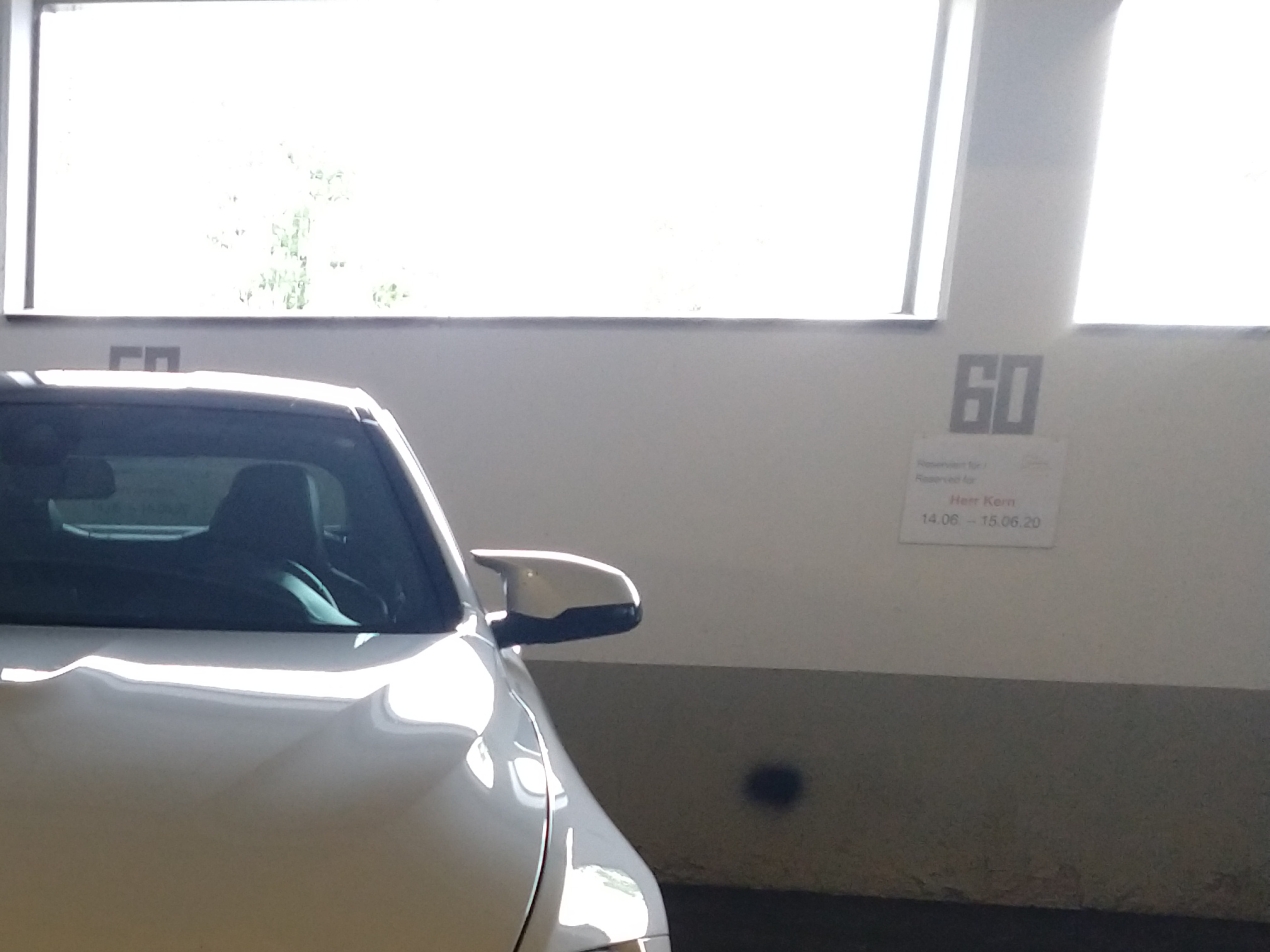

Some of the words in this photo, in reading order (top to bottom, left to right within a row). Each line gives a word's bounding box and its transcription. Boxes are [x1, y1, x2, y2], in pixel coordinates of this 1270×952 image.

[949, 354, 1044, 434] 60
[949, 494, 979, 506] Herr
[983, 495, 1016, 507] Kern
[981, 515, 1041, 529] 15.06.20
